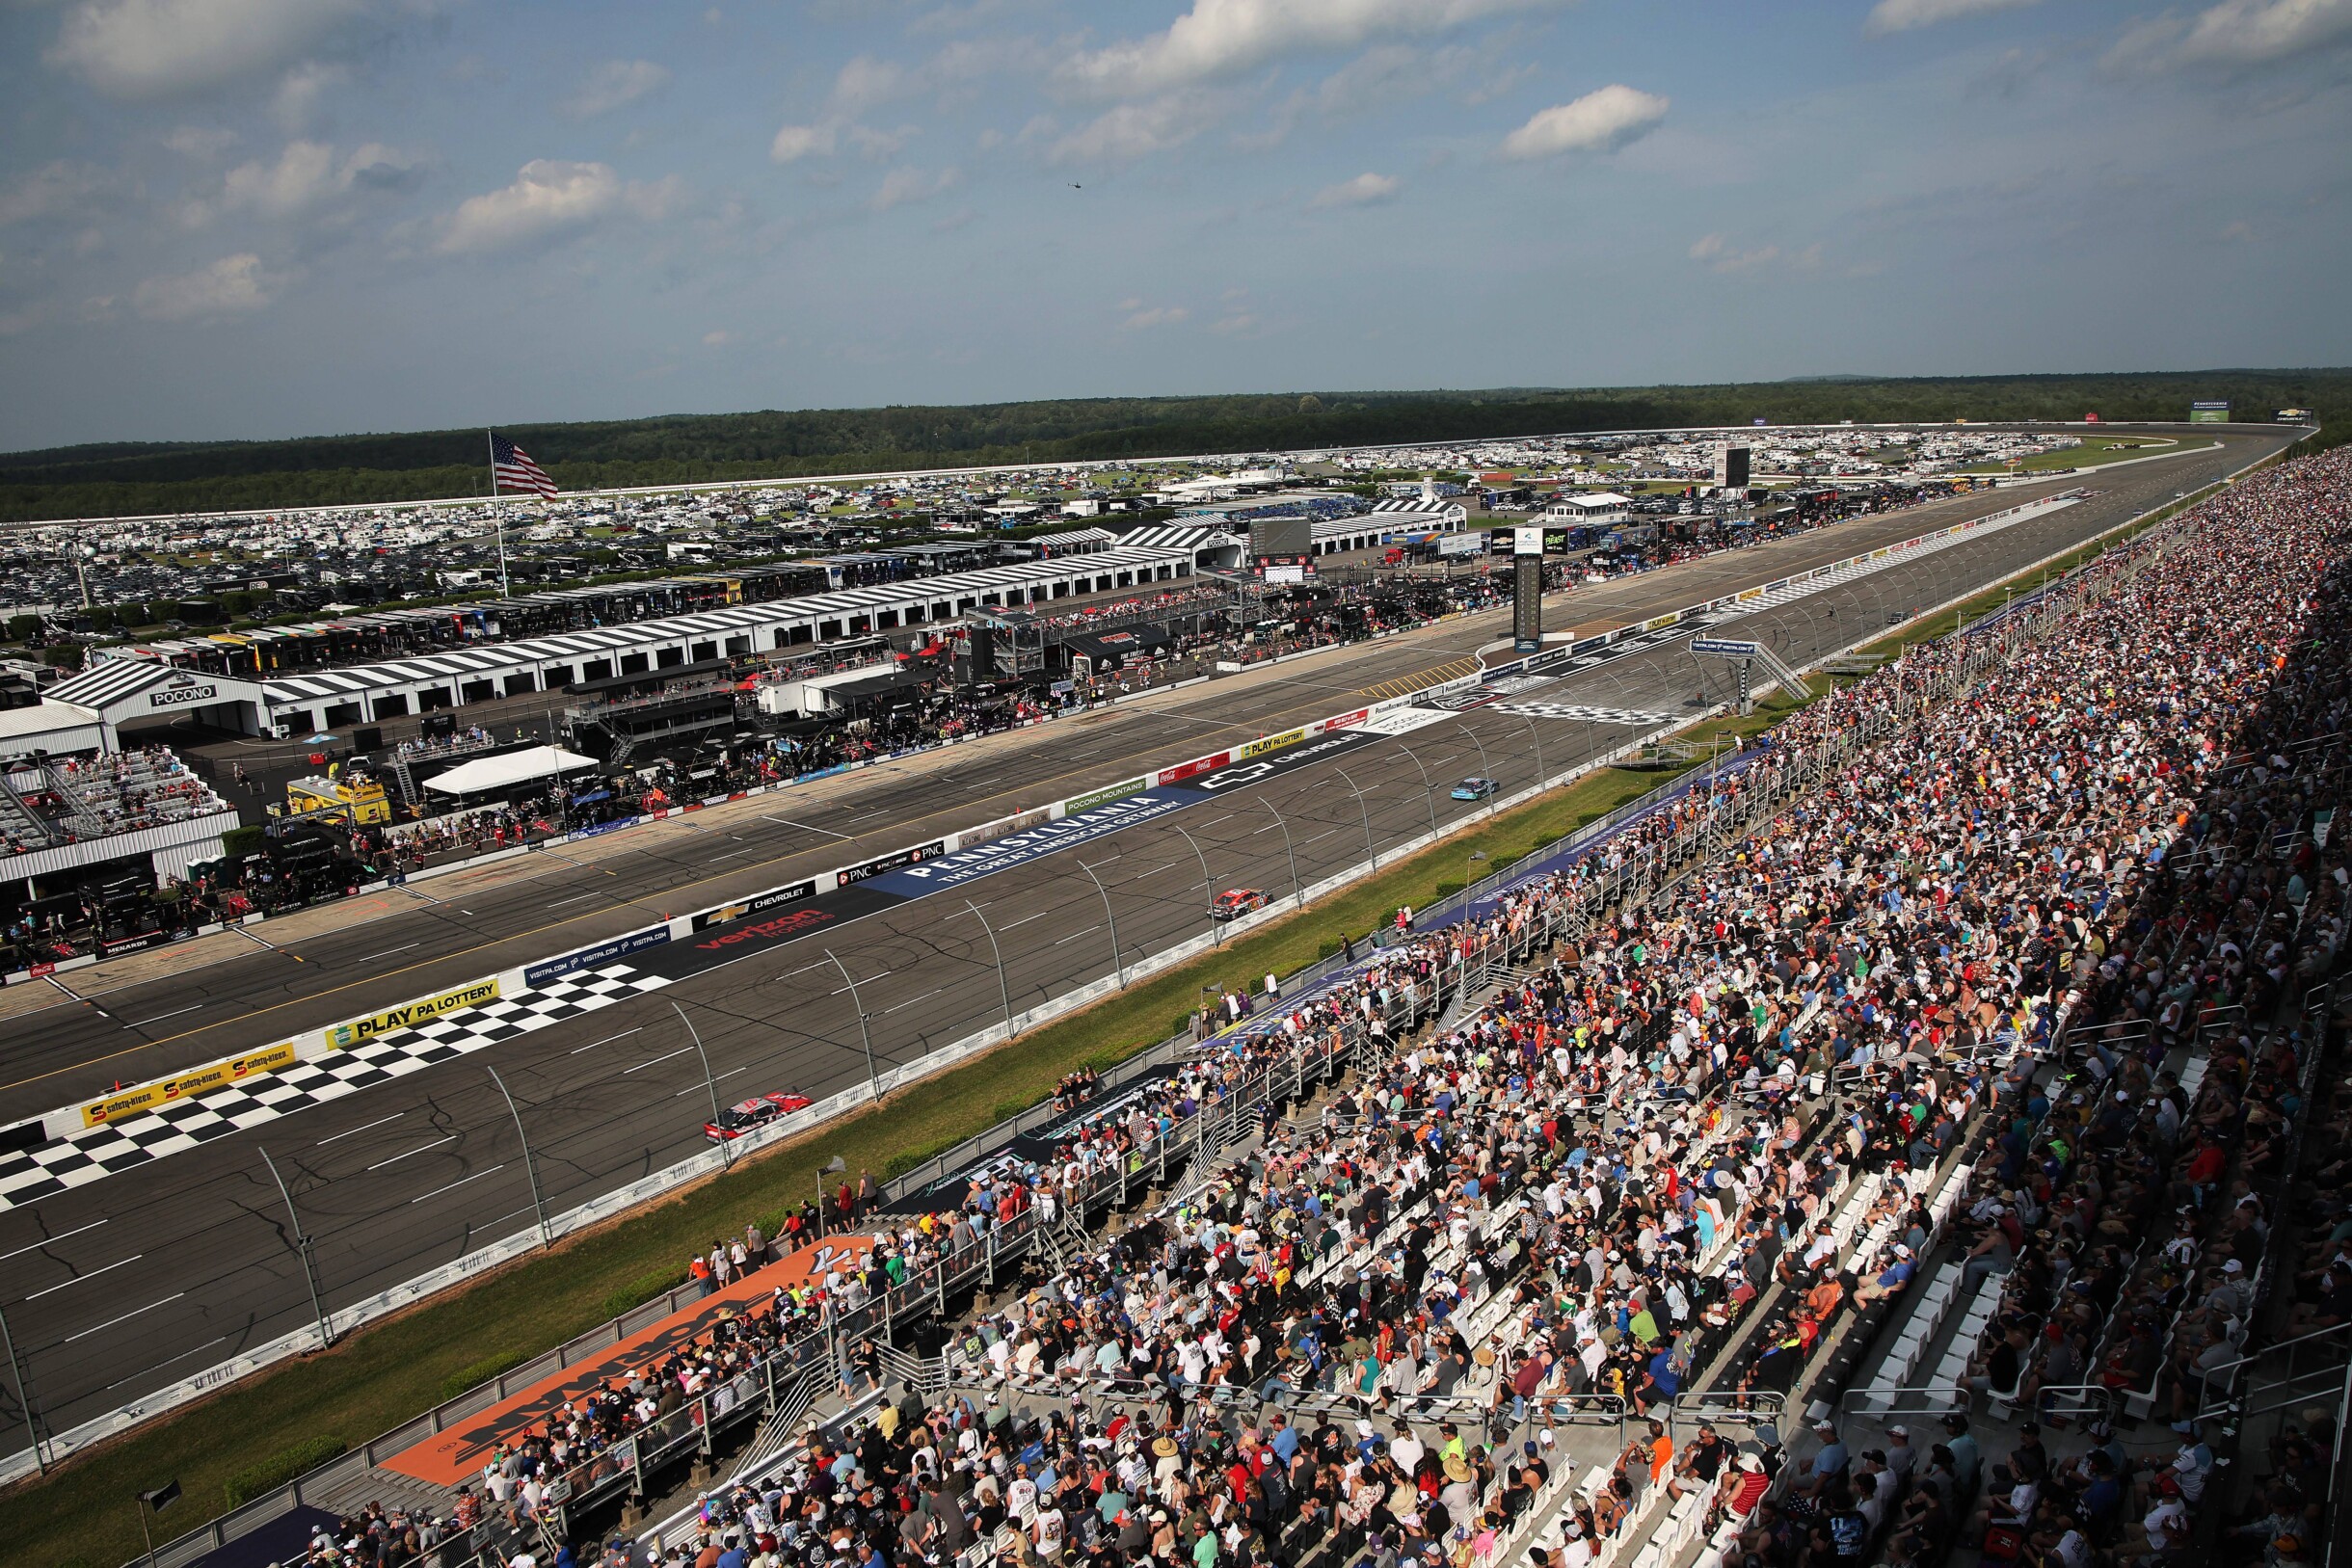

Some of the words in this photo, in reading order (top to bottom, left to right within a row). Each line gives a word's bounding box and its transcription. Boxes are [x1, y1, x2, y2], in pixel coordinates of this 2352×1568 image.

[1209, 539, 1228, 547] POCONO
[1545, 534, 1565, 545] BEAST
[1120, 652, 1130, 661] THE
[1119, 682, 1130, 692] 42
[154, 686, 212, 705] POCONO
[1252, 739, 1272, 755] PLAY
[1273, 738, 1281, 747] PA
[1282, 731, 1303, 744] LOTTERY
[1272, 732, 1365, 764] CHEVROLET
[769, 757, 776, 768] 7
[689, 767, 717, 781] DORMAN
[654, 788, 663, 802] 60
[702, 793, 729, 806] DORMAN
[1068, 796, 1101, 811] POCONO
[284, 811, 310, 822] POCONO
[904, 796, 1161, 879] PENNSYLVANIA
[937, 869, 978, 884] THE
[976, 850, 1029, 875] GREAT
[1034, 824, 1111, 854] AMERICAN
[1109, 800, 1184, 827] GETAWAY
[243, 853, 260, 864] JGR
[922, 844, 943, 859] PNC
[850, 865, 871, 882] PNC
[755, 887, 804, 910] CHEVROLET
[694, 908, 823, 950] verizon
[763, 914, 836, 939] frontline
[108, 940, 147, 954] MENARDS
[632, 931, 667, 947] VISITPA.COM
[582, 946, 618, 964] VISITPA.COM
[33, 965, 52, 975] Coca-Cola
[530, 962, 567, 979] VISITPA.COM
[357, 1008, 413, 1038] PLAY
[416, 1003, 436, 1018] PA
[438, 983, 494, 1010] LOTTERY
[248, 1050, 287, 1070] safety-kleen
[179, 1072, 222, 1092] safety-kleen
[107, 1093, 152, 1114] safety-kleen
